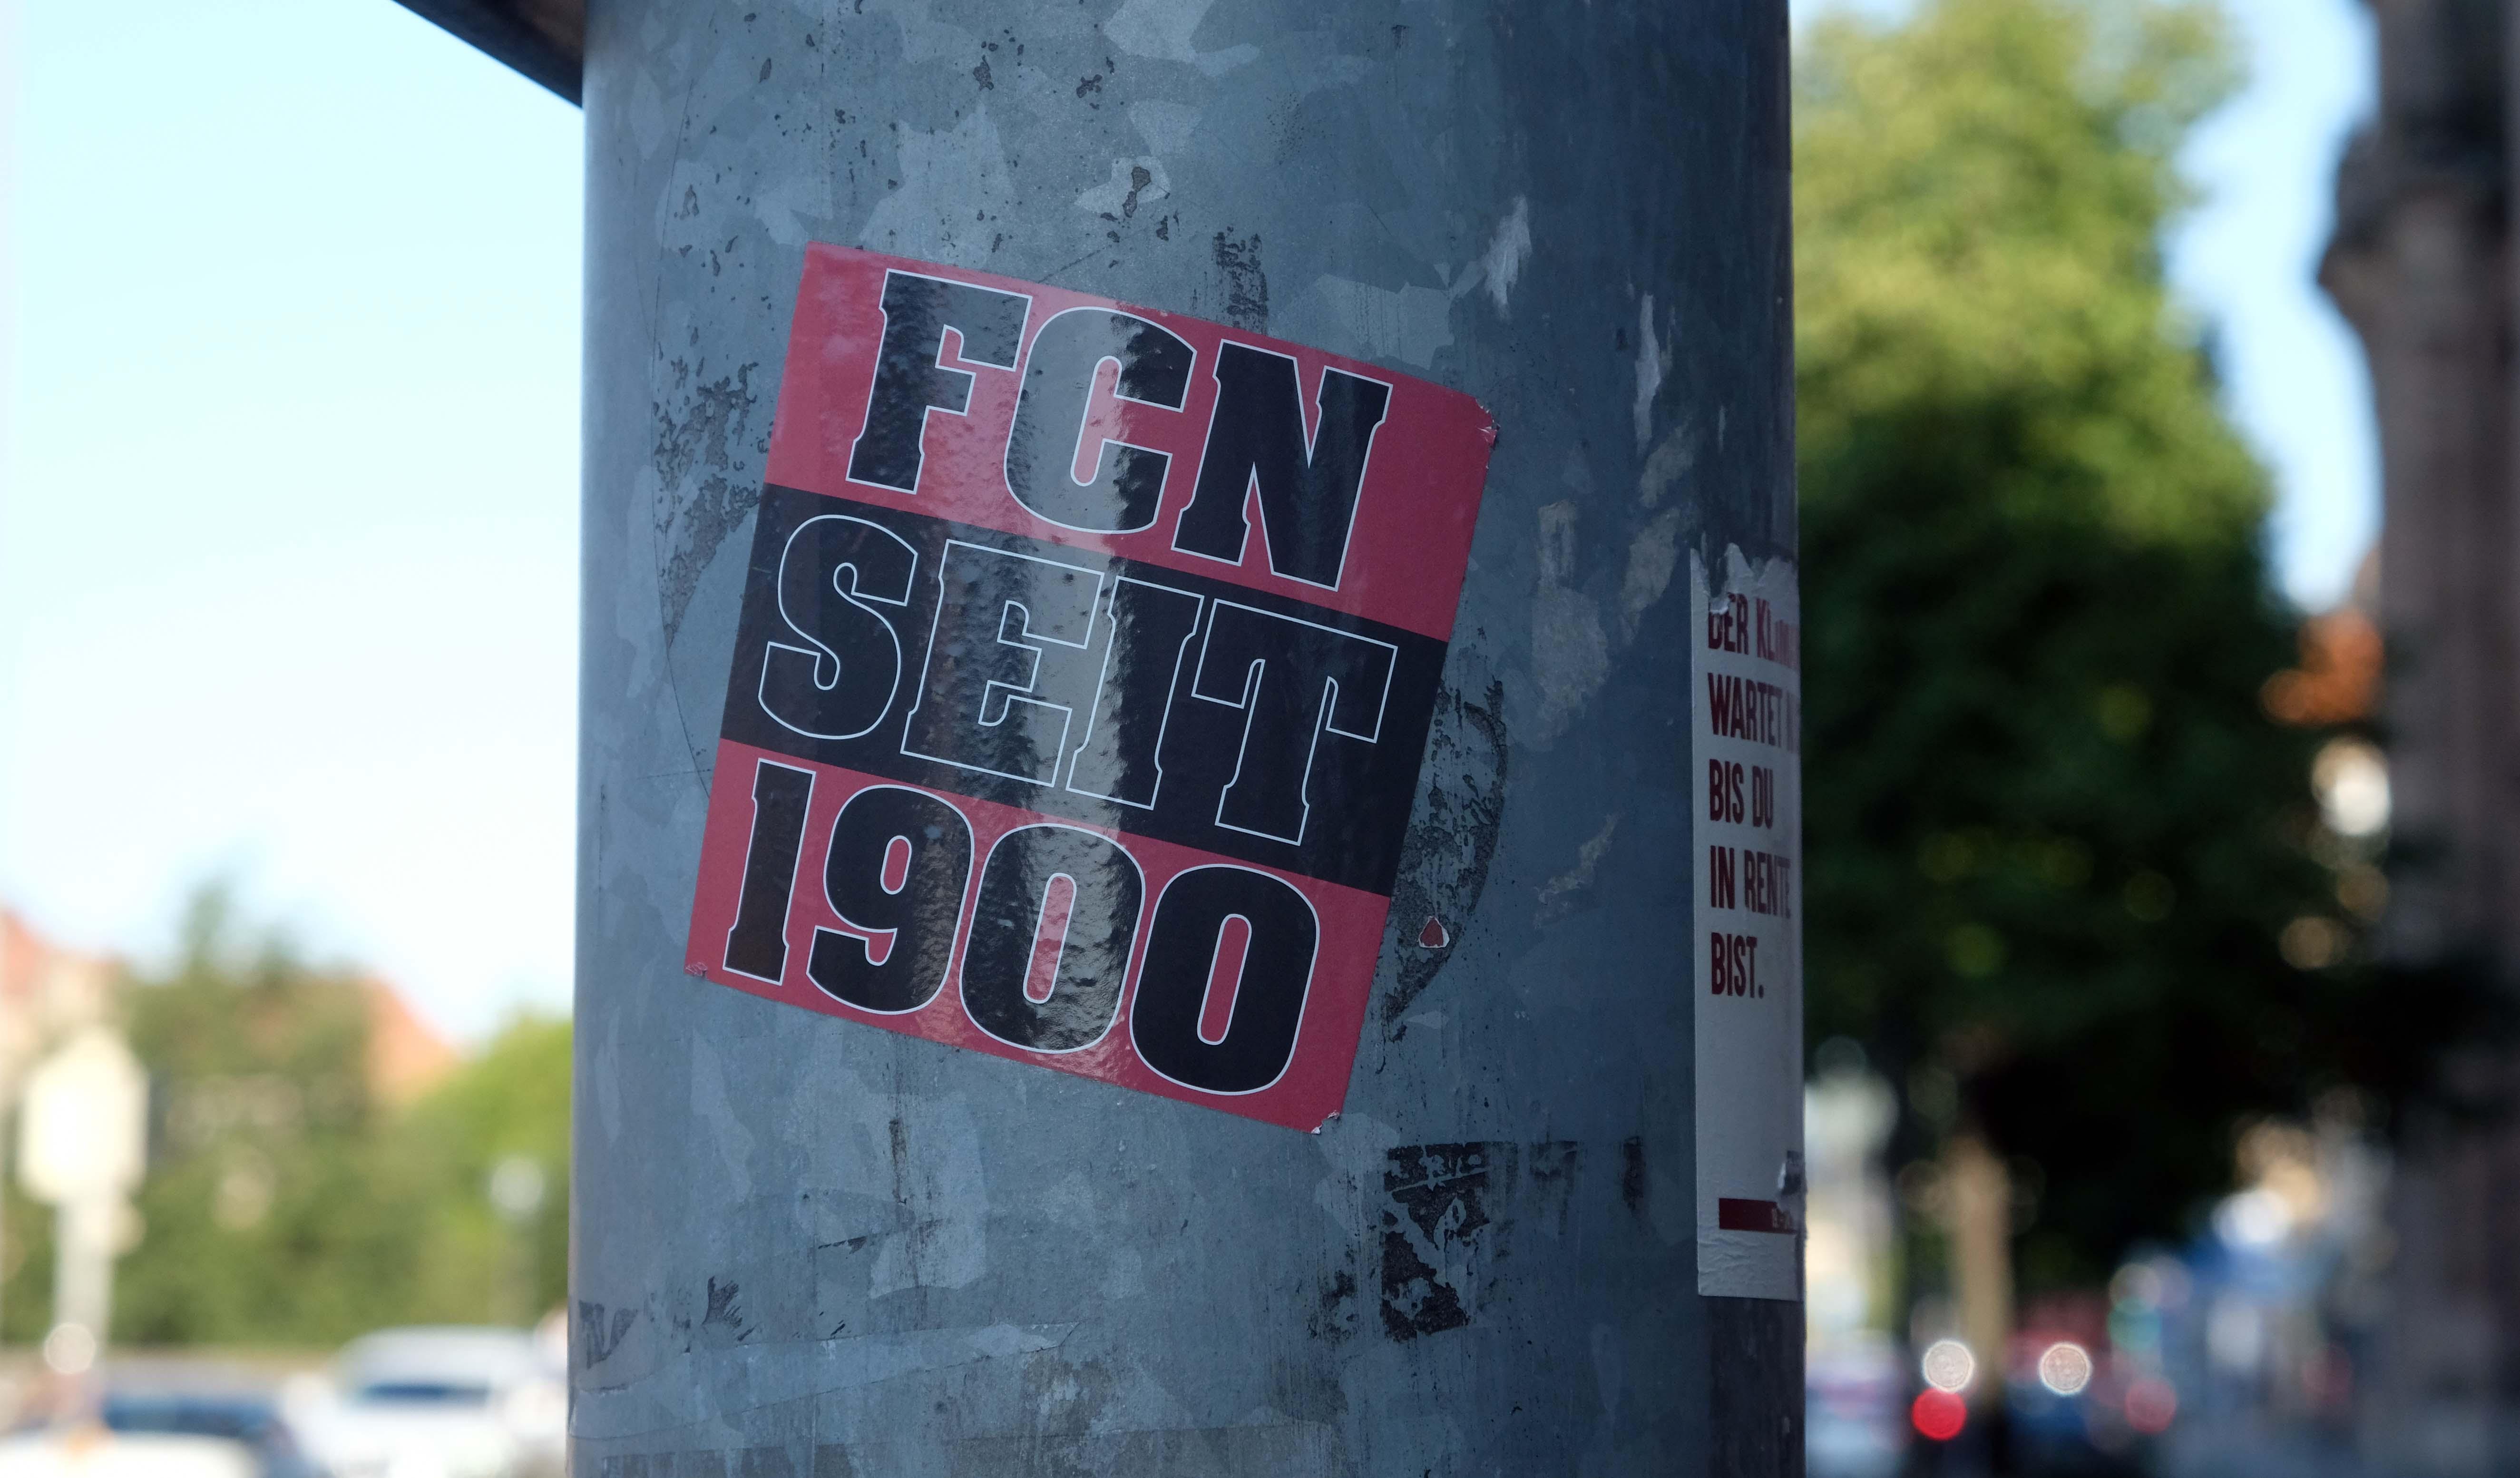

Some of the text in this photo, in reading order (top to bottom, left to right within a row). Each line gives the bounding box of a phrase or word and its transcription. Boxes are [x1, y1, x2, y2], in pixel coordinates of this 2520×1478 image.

[846, 268, 1393, 592] FCN
[1708, 592, 1749, 655] DER
[757, 514, 1398, 846] SEIT
[1707, 672, 1783, 748] WARTET
[1709, 759, 1773, 830] BIS DU
[1710, 845, 1792, 919] IN RENTE
[723, 758, 1321, 1096] 1900
[1711, 932, 1764, 998] BIST.
